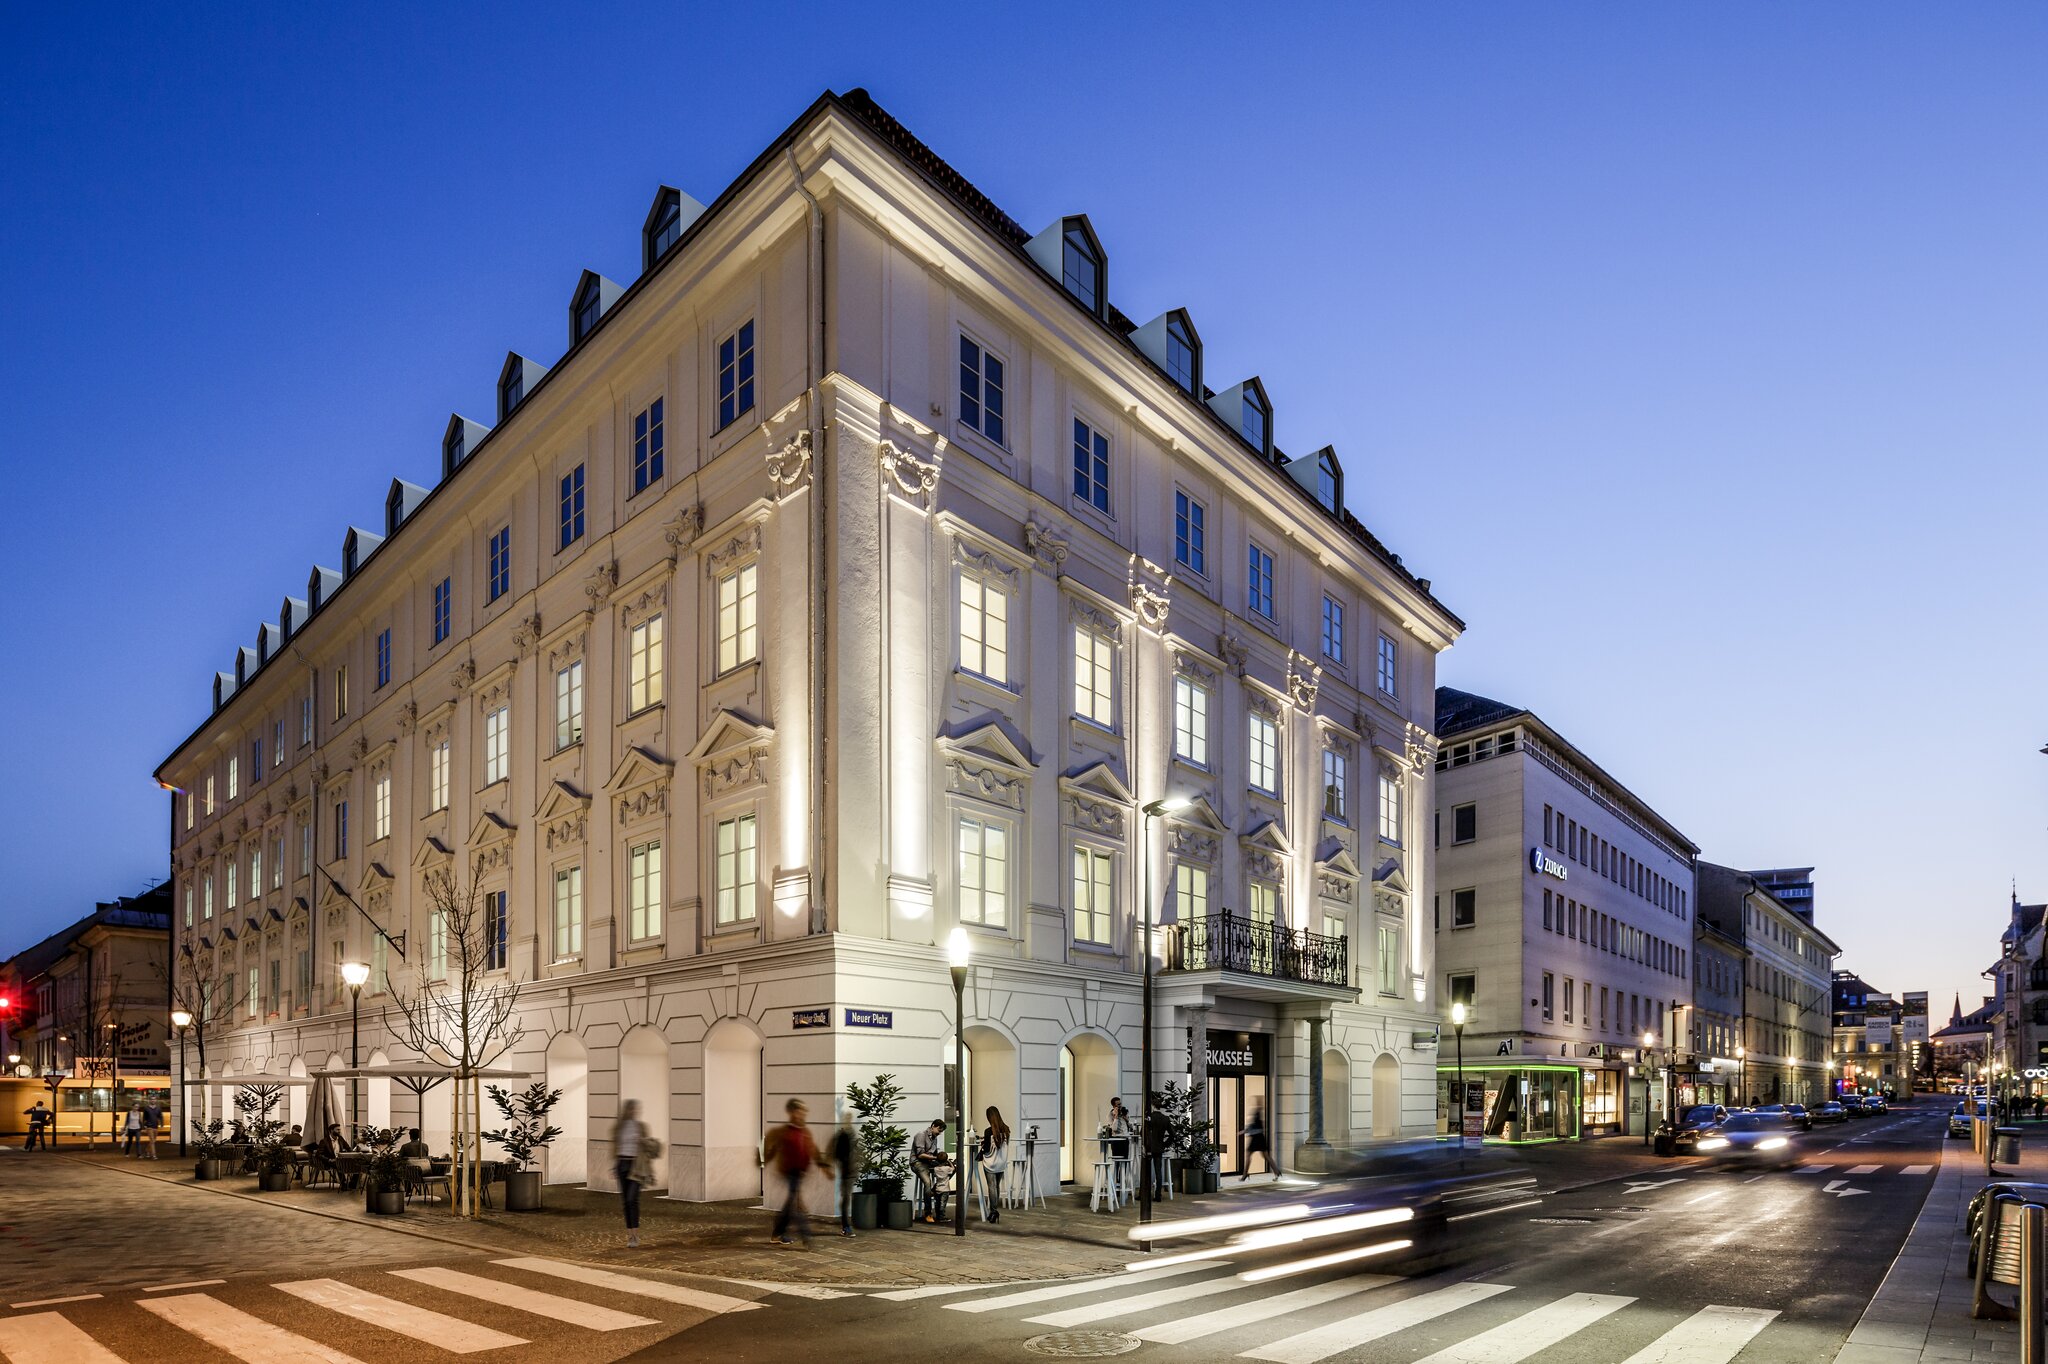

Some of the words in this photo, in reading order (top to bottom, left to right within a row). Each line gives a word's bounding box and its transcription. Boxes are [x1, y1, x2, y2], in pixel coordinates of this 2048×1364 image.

[851, 1011, 871, 1024] Neuer
[872, 1013, 888, 1025] Platz
[1497, 1038, 1513, 1056] A1
[1587, 1044, 1600, 1057] A1
